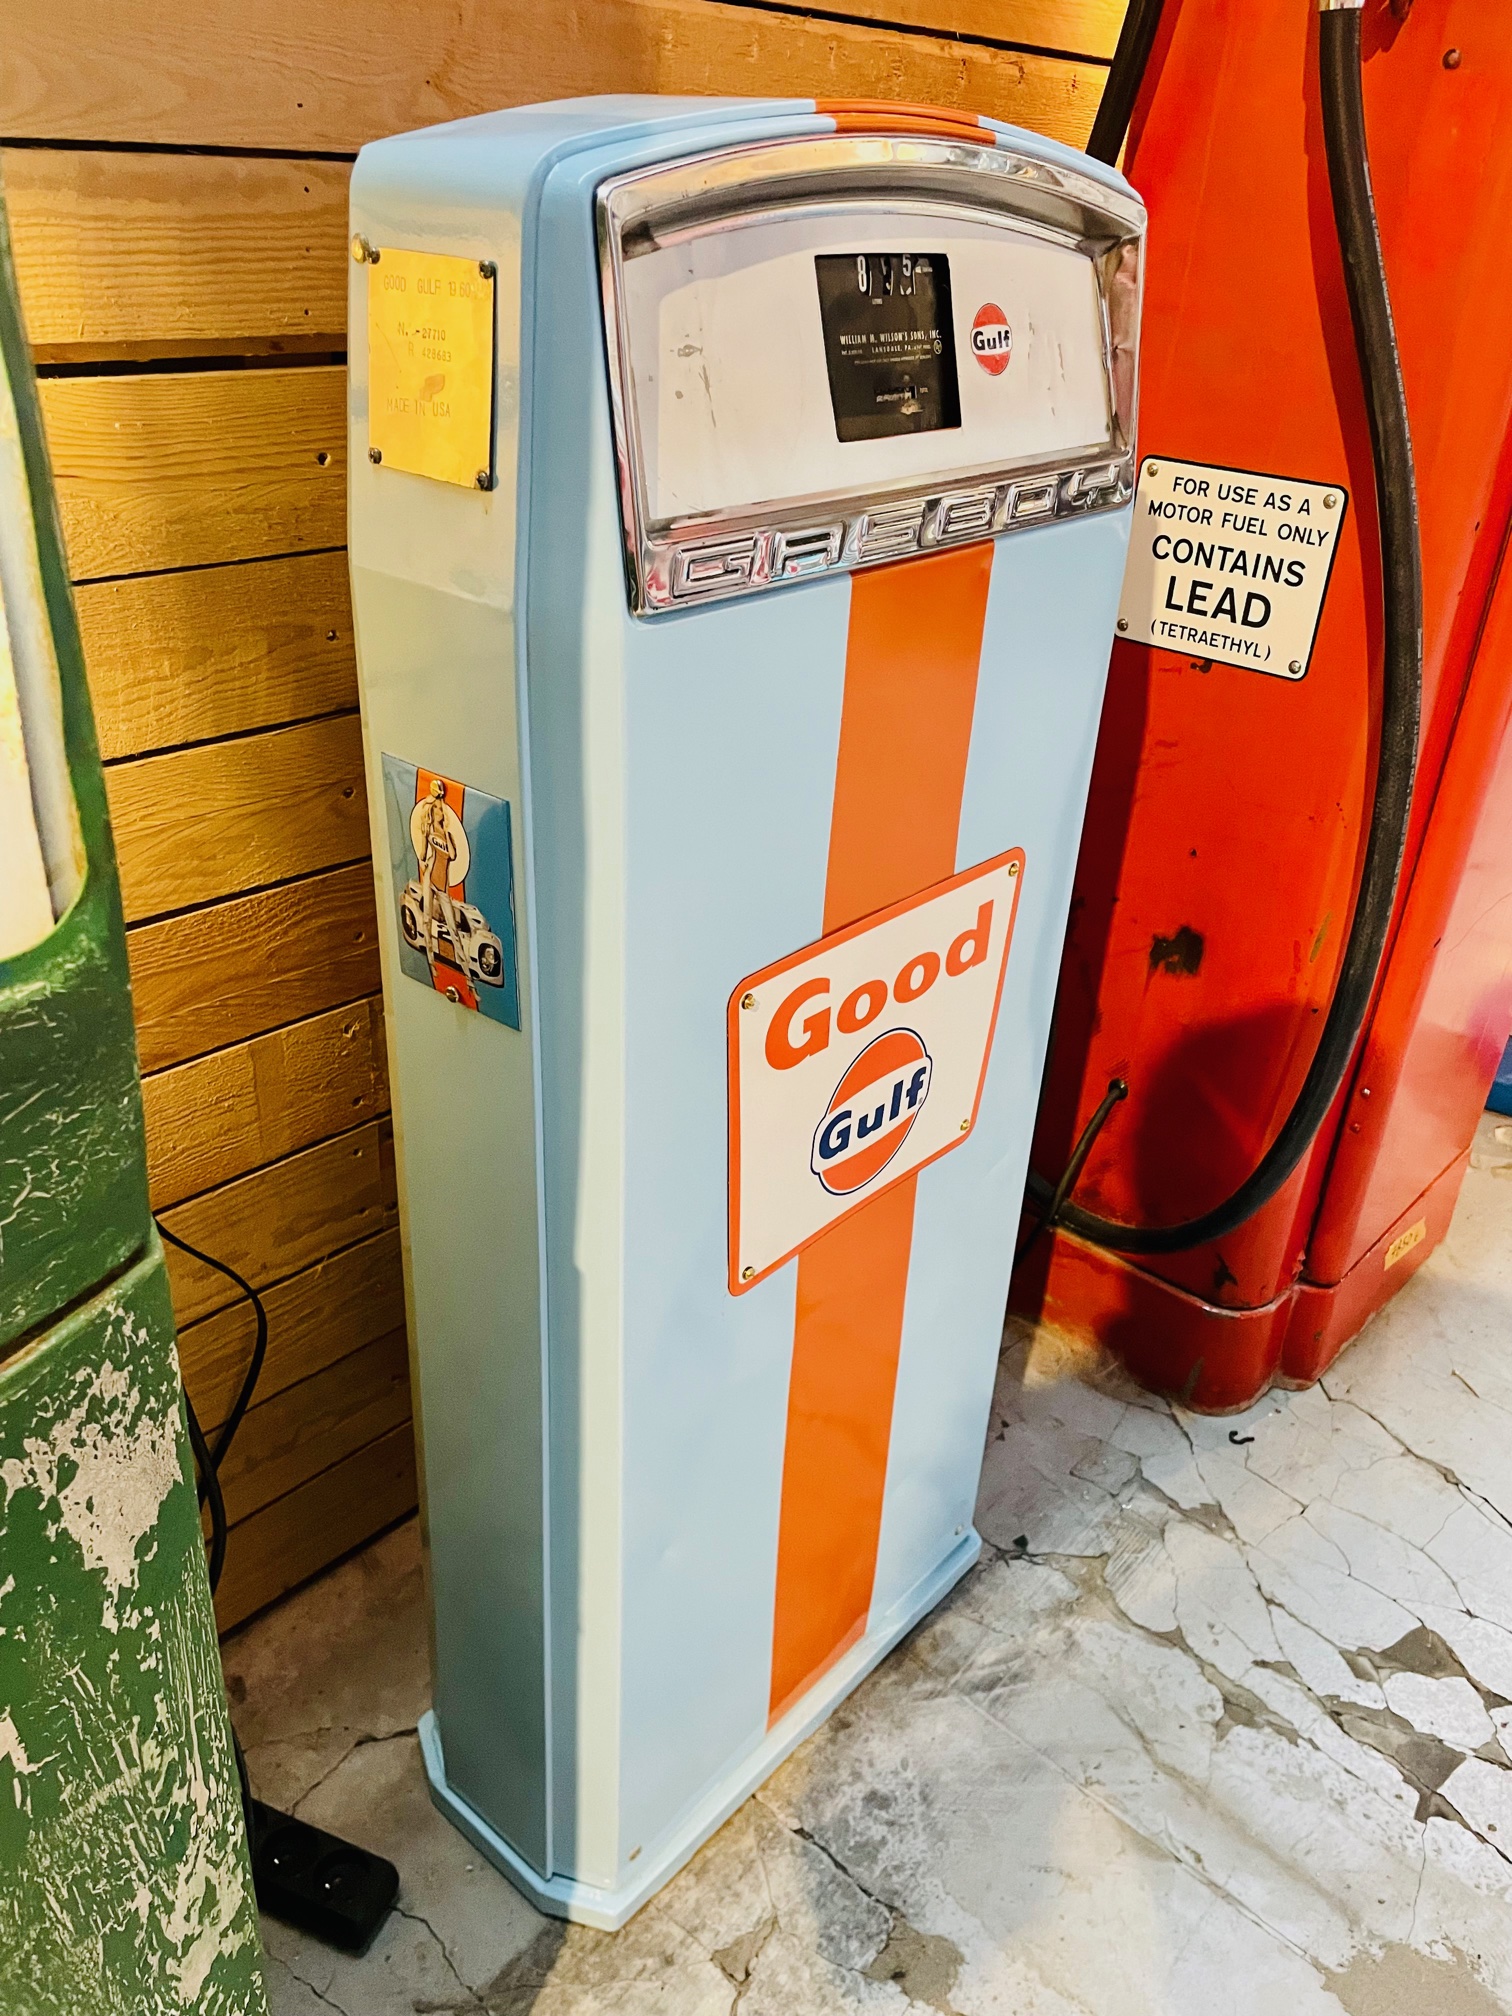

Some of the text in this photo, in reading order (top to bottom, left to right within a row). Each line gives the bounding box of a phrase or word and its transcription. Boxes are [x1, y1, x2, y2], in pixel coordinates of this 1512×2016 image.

[383, 274, 407, 292] GOOD
[417, 278, 441, 295] GULF
[839, 332, 867, 345] WILLIAM
[879, 330, 909, 343] WILSON'S
[929, 329, 942, 340] INC.
[972, 329, 1010, 350] Gulf
[386, 397, 452, 418] MADE IN USA
[1172, 476, 1311, 515] FOR USE AS A
[671, 463, 1122, 600] GASBOY
[1148, 500, 1330, 547] MOTOR FUEL ONLY
[1151, 534, 1306, 587] CONTAINS
[1165, 575, 1272, 629] LEAD
[1150, 619, 1272, 662] (TETRAETHYL)
[764, 899, 994, 1070] Good
[818, 1066, 927, 1161] Gulf
